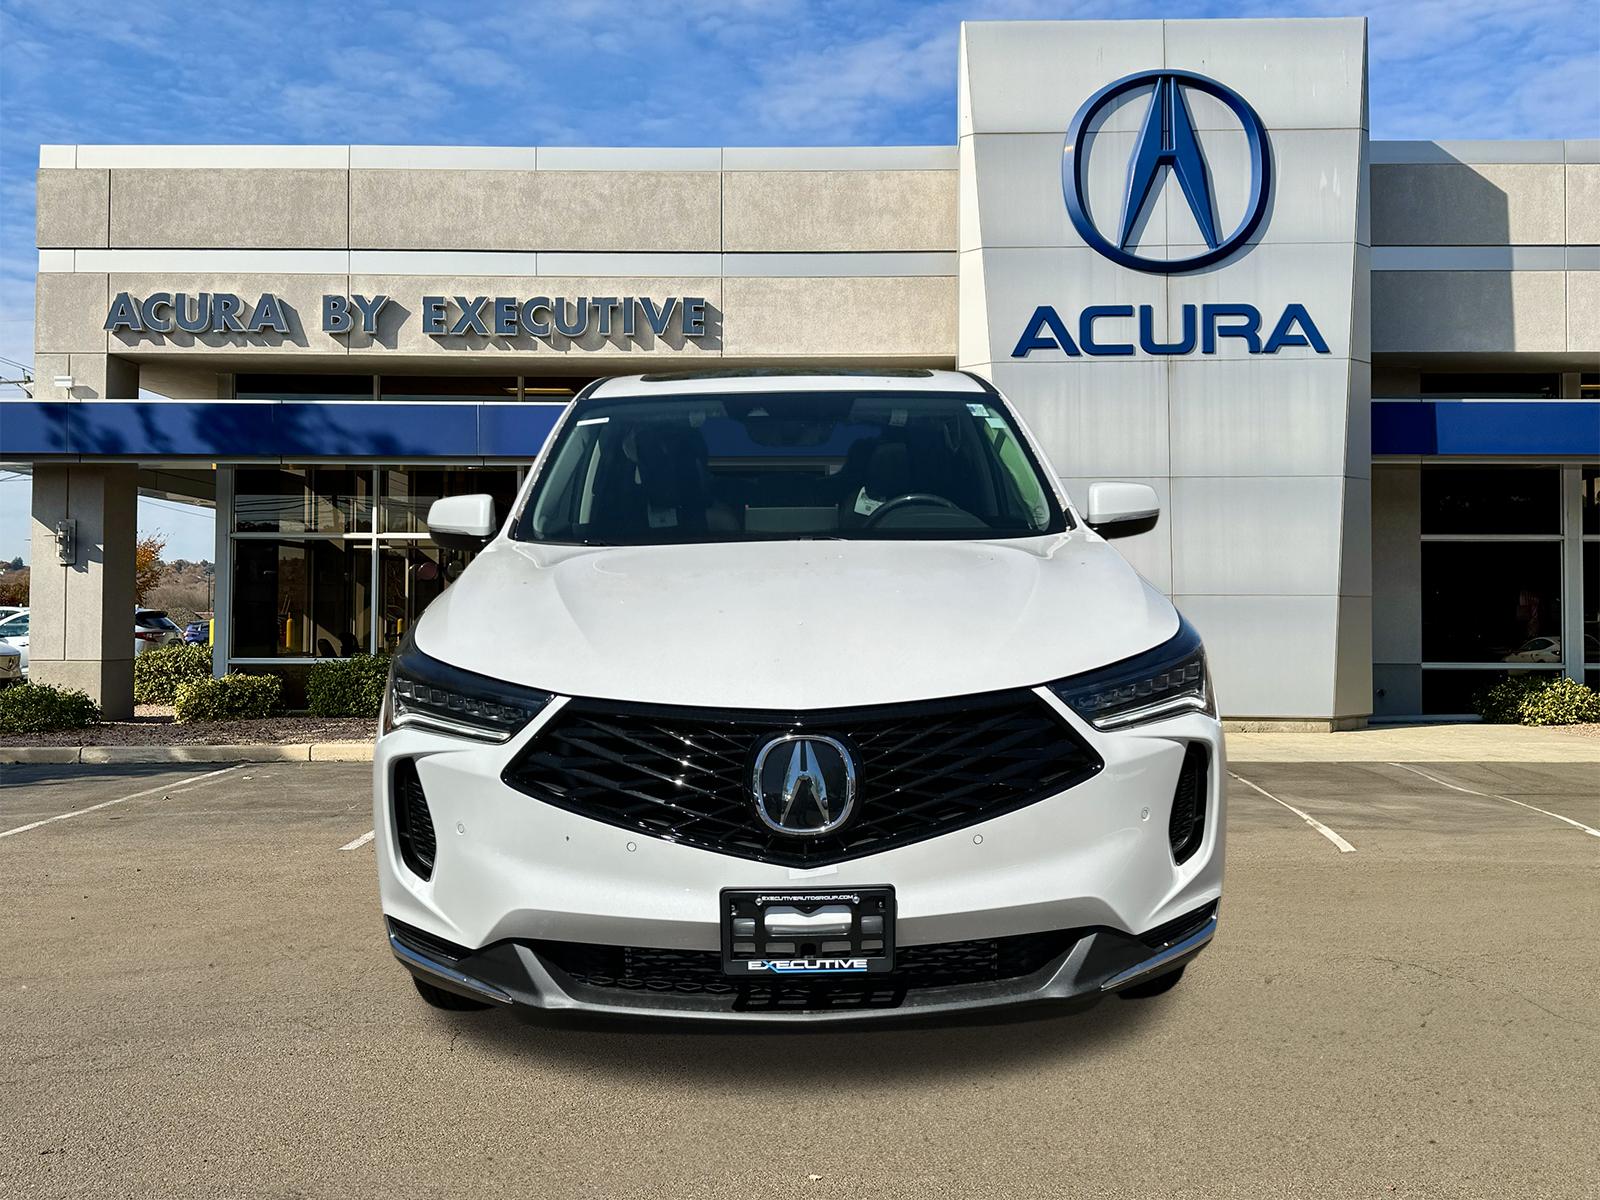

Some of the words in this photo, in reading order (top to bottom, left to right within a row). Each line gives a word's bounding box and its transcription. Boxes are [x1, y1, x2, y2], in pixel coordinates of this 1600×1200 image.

[104, 292, 290, 334] ACURA
[322, 294, 393, 335] BY
[422, 296, 707, 338] EXECUTIVE
[1011, 303, 1331, 357] ACURA
[761, 894, 854, 902] EXECUTIVEAUTOGROUP.COM
[747, 959, 868, 972] EXECUTIVE
